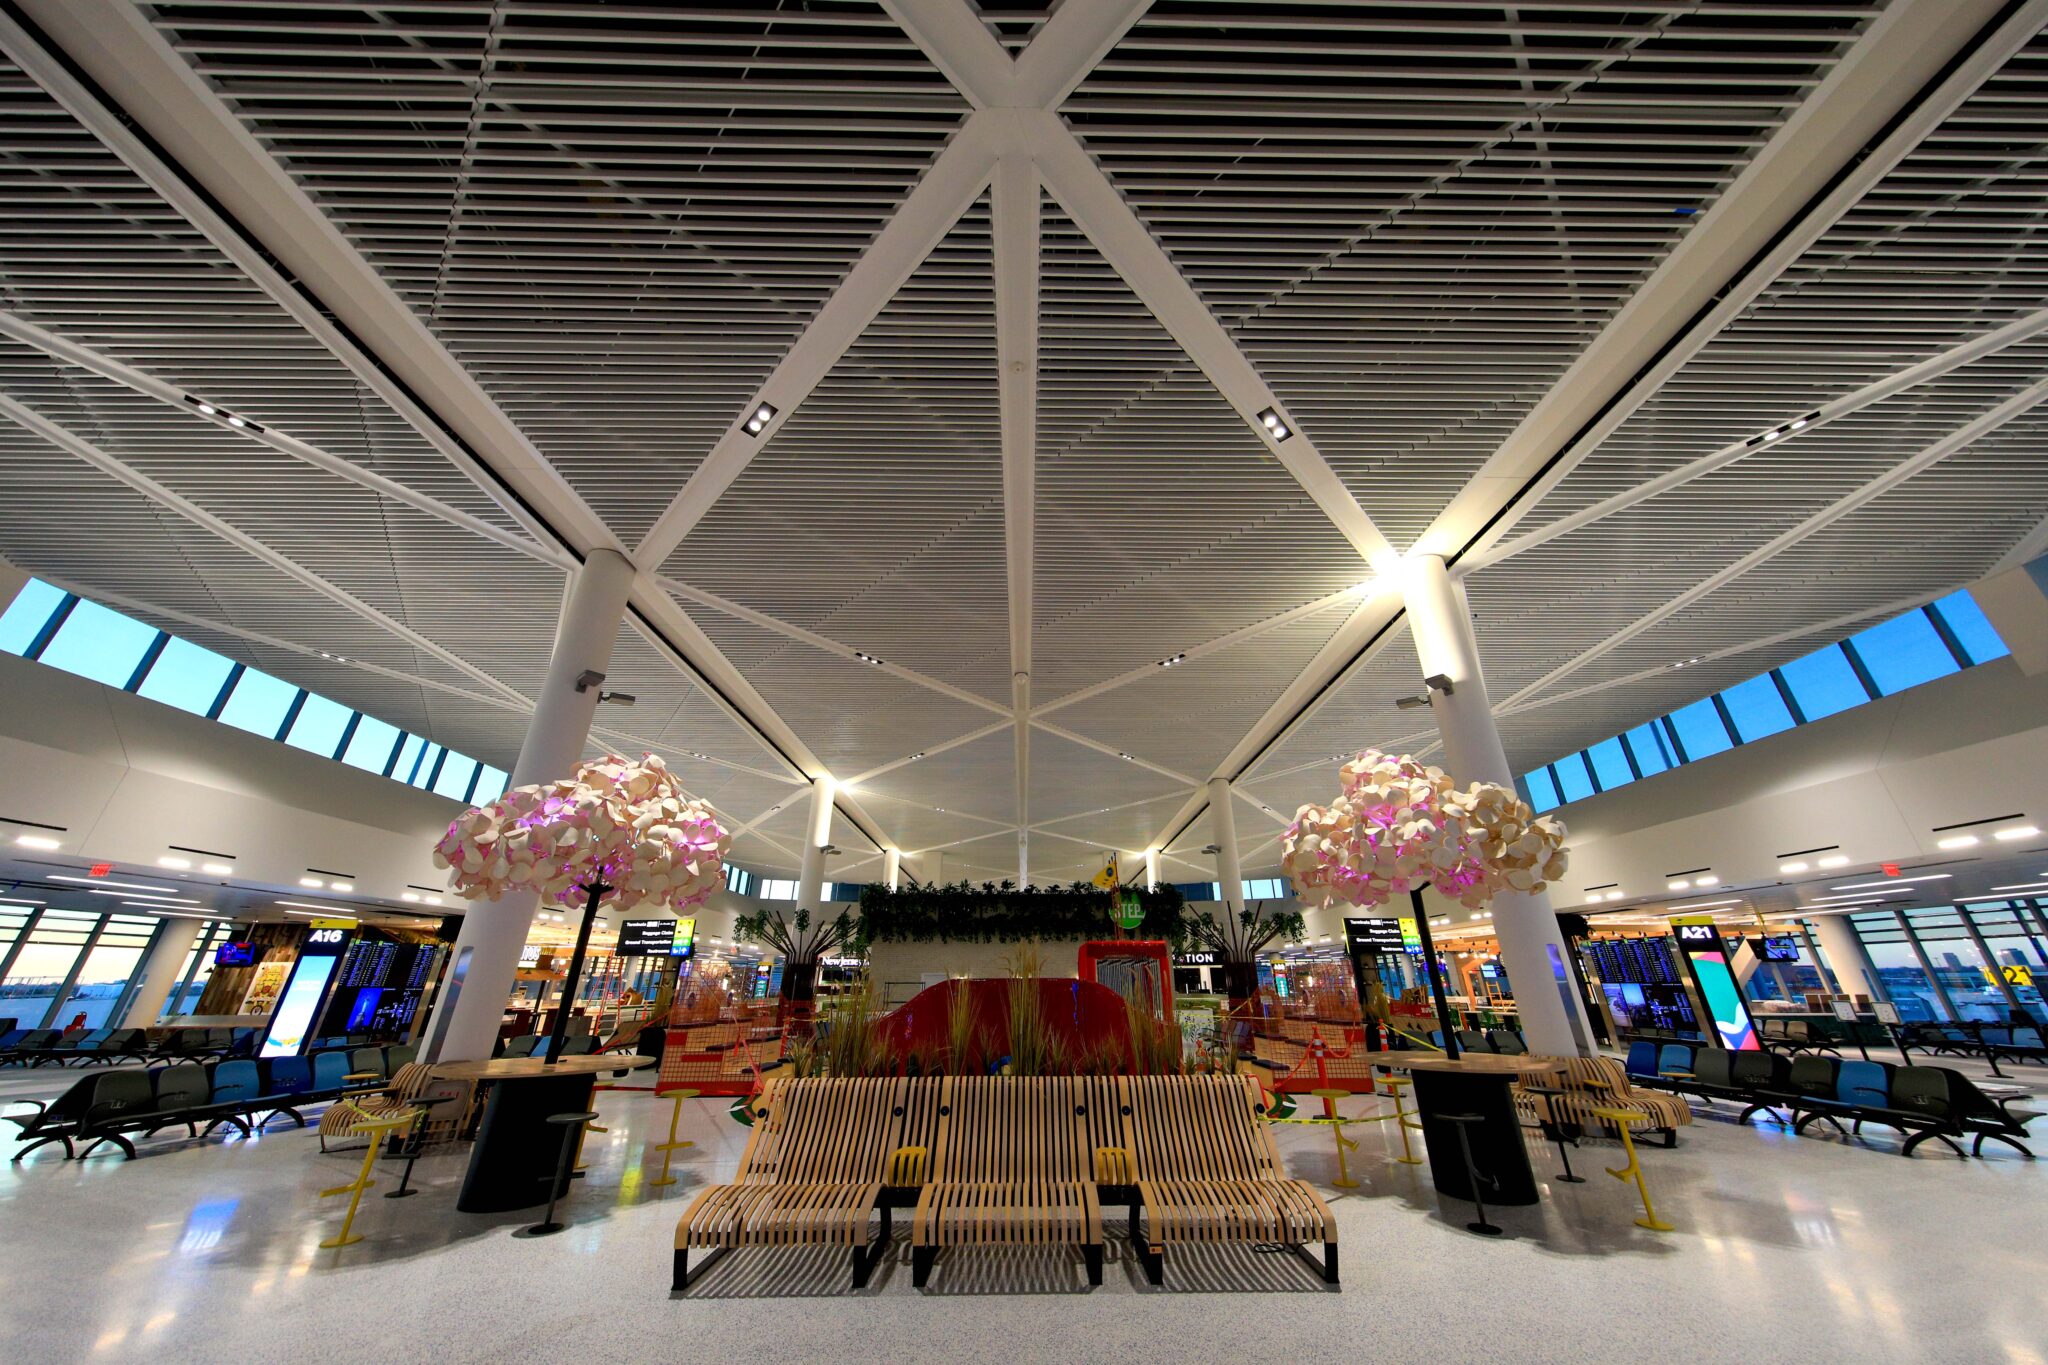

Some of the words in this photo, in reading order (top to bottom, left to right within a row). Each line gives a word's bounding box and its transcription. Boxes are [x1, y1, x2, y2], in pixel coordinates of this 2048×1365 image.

[309, 929, 344, 942] A16
[1682, 926, 1712, 938] A21
[821, 955, 840, 966] New
